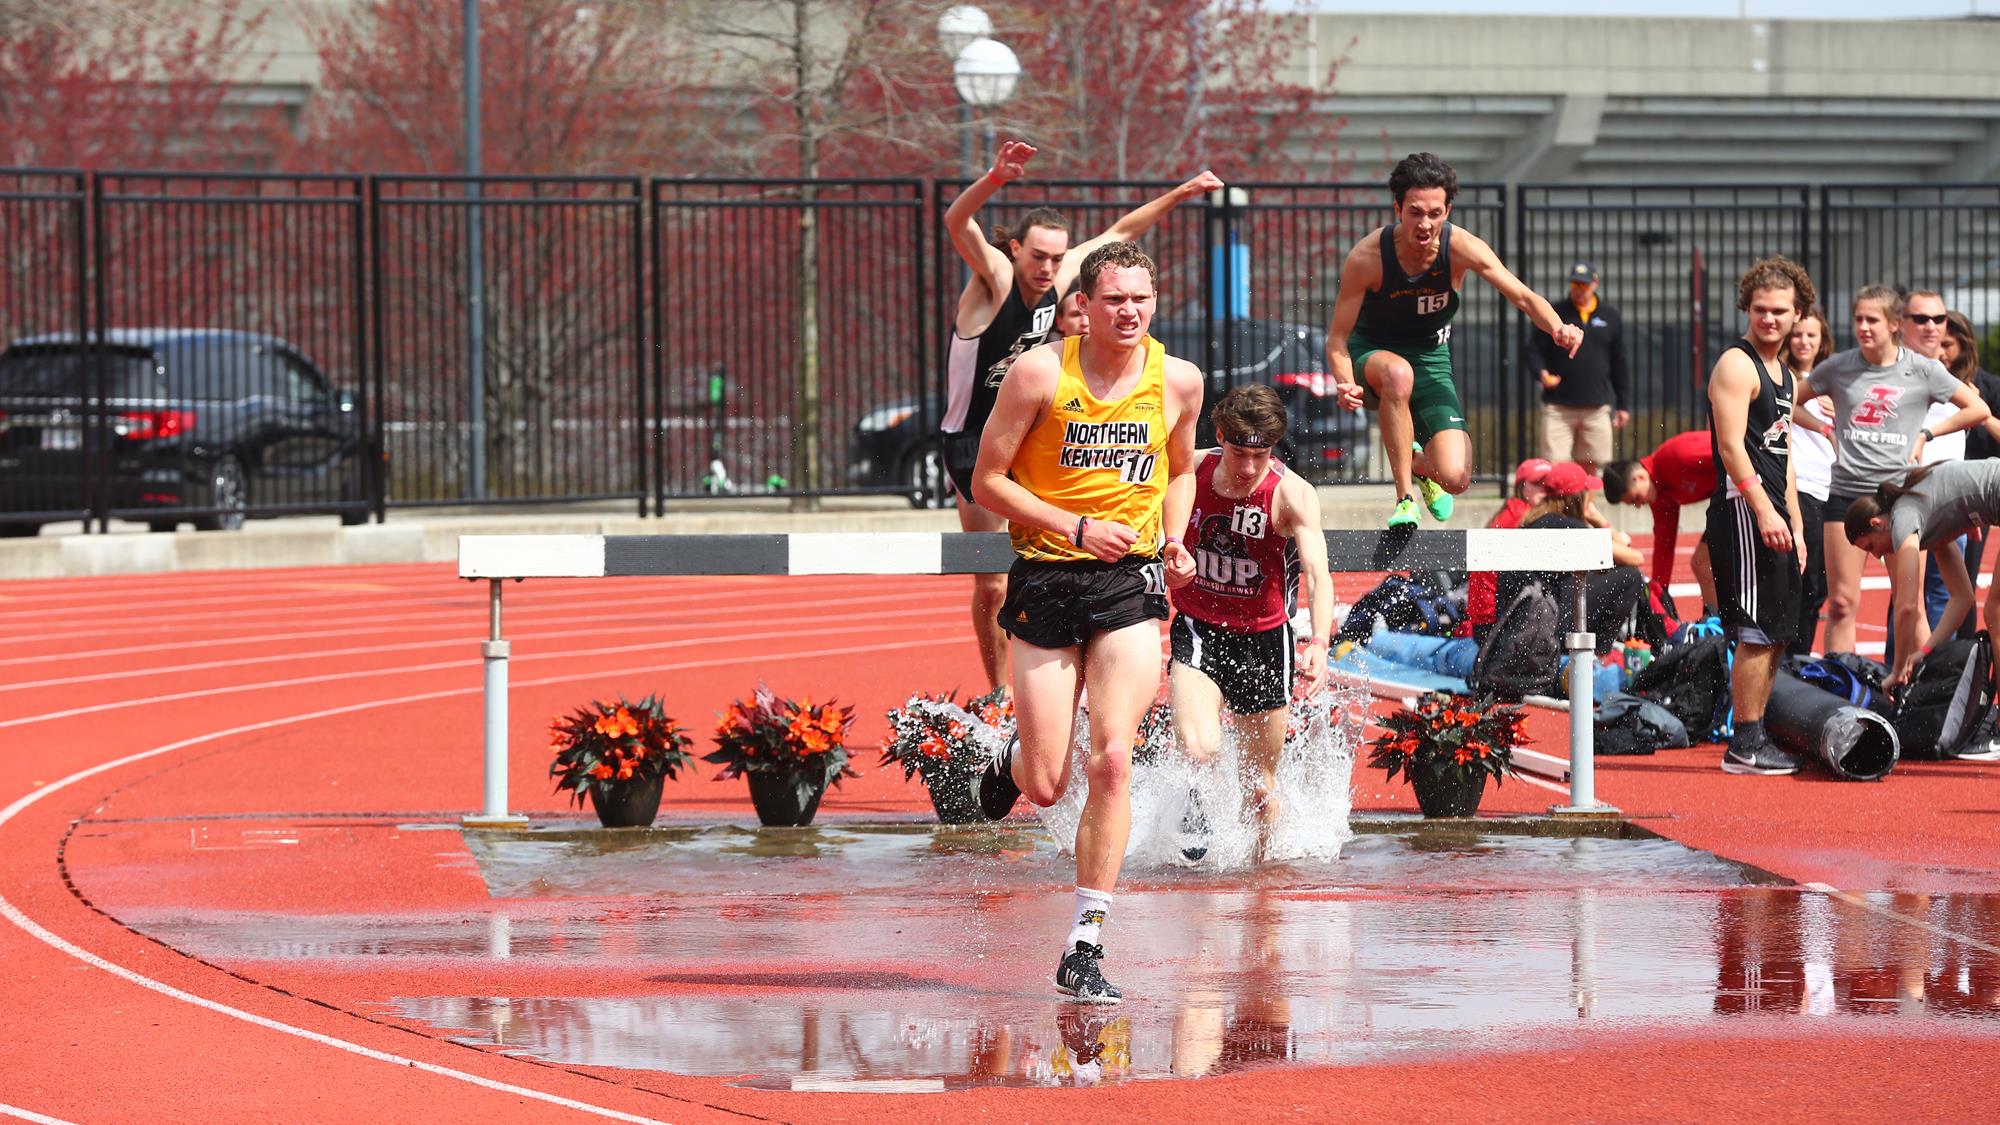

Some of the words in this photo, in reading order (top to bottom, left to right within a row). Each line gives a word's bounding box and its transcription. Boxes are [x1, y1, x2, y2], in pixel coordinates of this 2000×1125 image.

[1420, 294, 1445, 313] 15
[1035, 308, 1054, 331] 17
[1062, 405, 1085, 414] adidas
[1064, 421, 1149, 445] NORTHERN
[1880, 432, 1908, 445] FIELD
[1060, 446, 1145, 468] KENTUC
[1126, 454, 1155, 482] 10
[1235, 508, 1262, 536] 13
[1195, 548, 1259, 587] IUP
